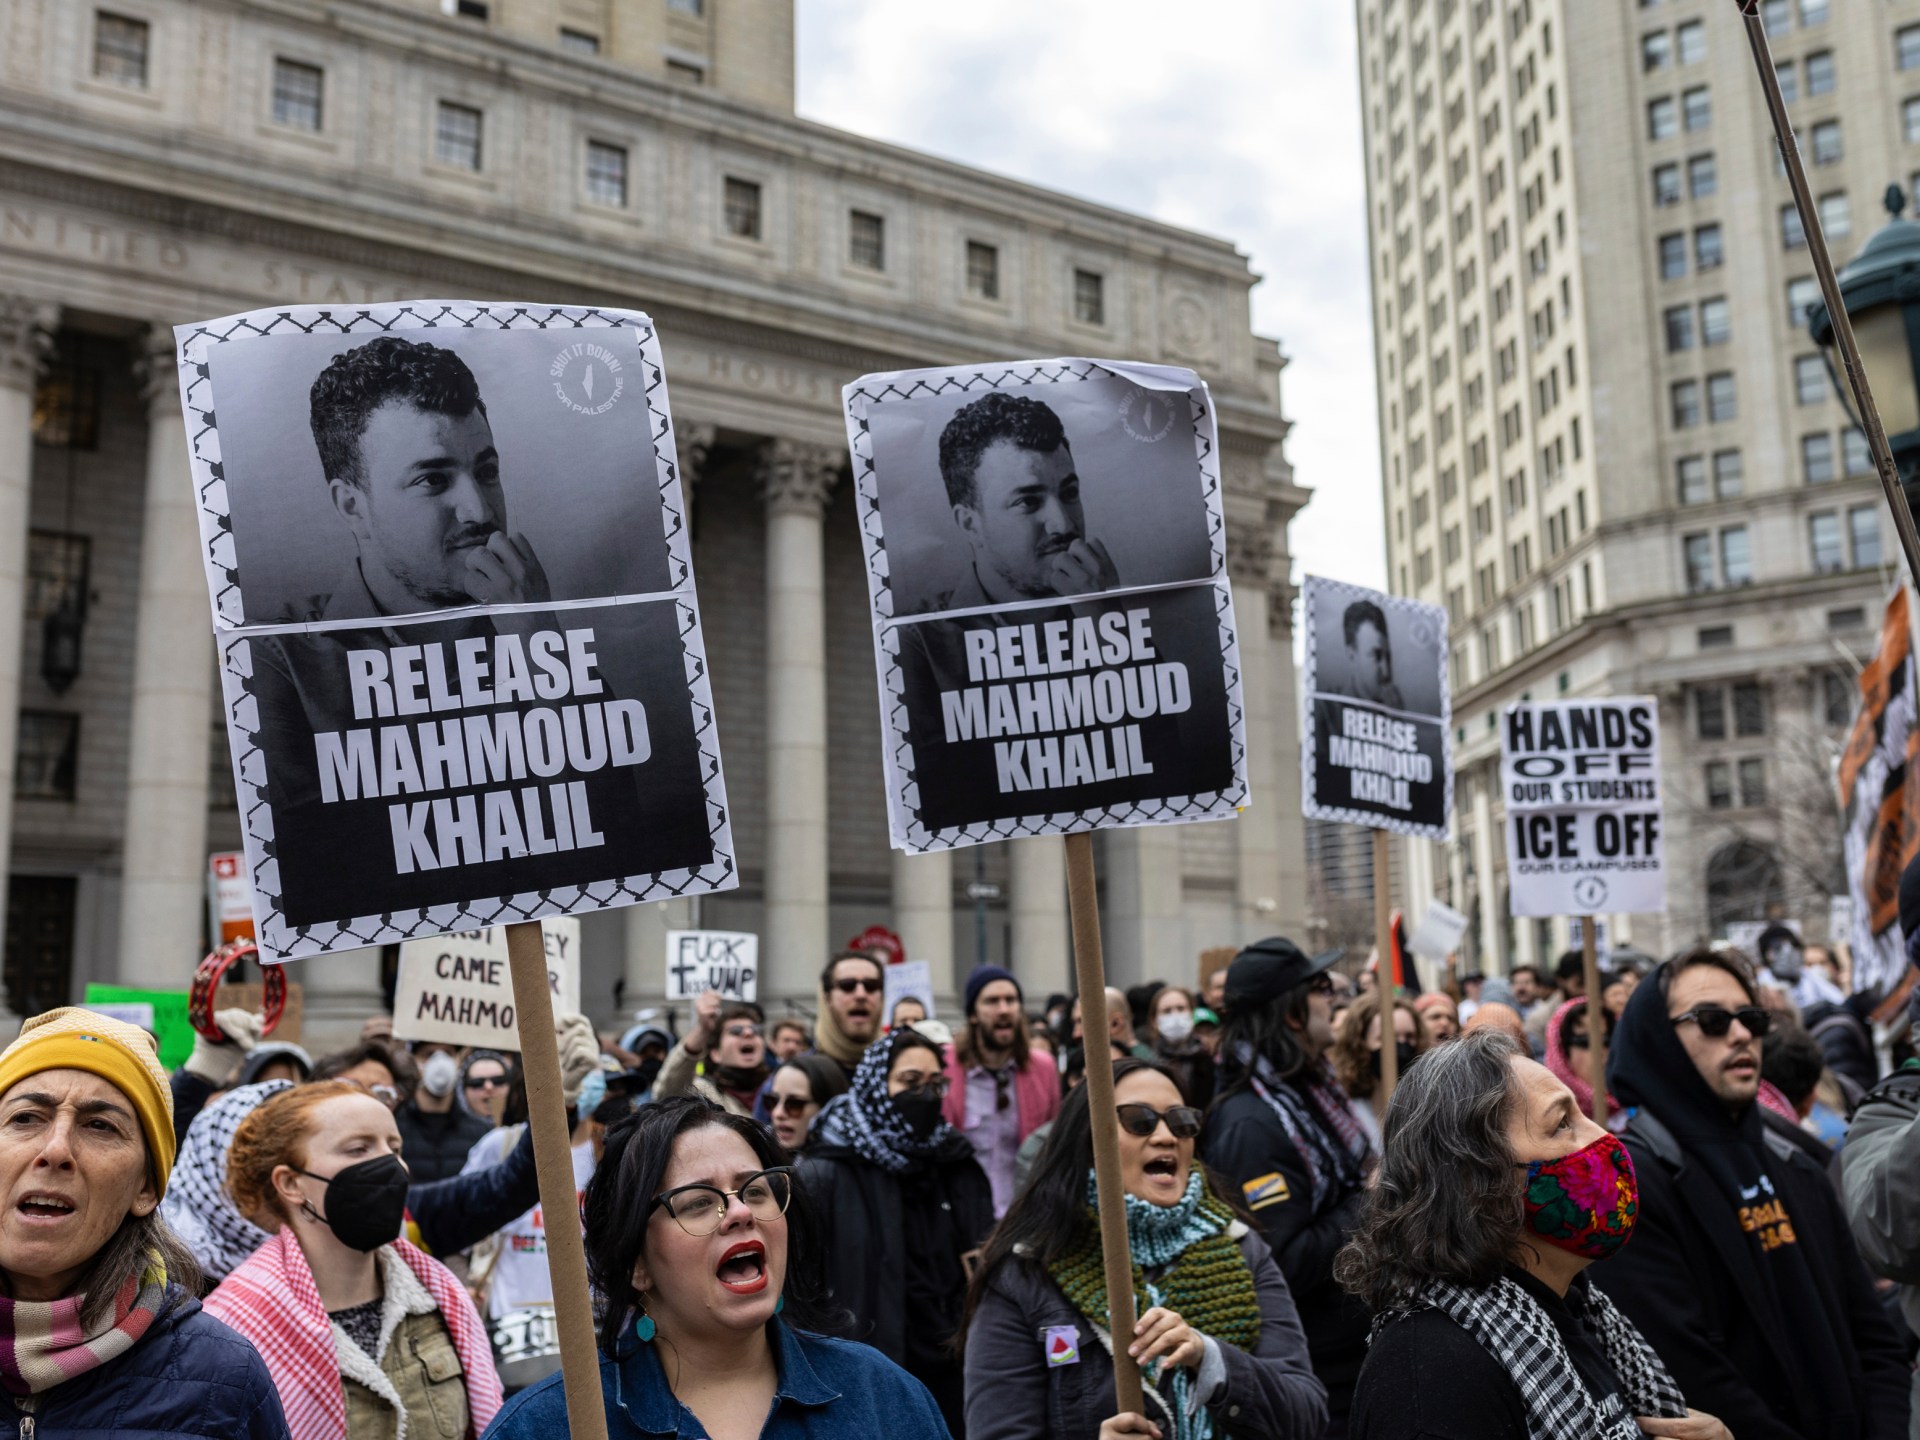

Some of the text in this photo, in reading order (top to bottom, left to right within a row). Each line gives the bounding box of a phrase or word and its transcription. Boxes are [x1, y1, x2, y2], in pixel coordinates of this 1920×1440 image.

[3, 209, 189, 272] NITED
[550, 343, 623, 378] SHUT IT DOWN!
[553, 377, 623, 416] FOR PALESTINE
[964, 608, 1156, 682] RELEASE
[346, 628, 604, 720] RELEASE
[941, 661, 1192, 743] MAHMOUD
[314, 699, 652, 804] MAHMOUD
[1342, 707, 1418, 753] RELEASE
[1508, 706, 1655, 753] HANDS
[994, 724, 1154, 793] KHALIL
[1329, 735, 1433, 784] MAHMOUD
[1512, 753, 1654, 778] OFF
[1350, 768, 1413, 811] KHALIL
[1512, 780, 1656, 803] OUR STUDENTS
[388, 780, 606, 875] KHALIL
[1514, 812, 1659, 860] ICE OFF
[1516, 859, 1660, 875] OUR CAMPUSES
[436, 952, 504, 986] CAME
[680, 936, 746, 965] FUCK
[416, 990, 515, 1030] MAHMO
